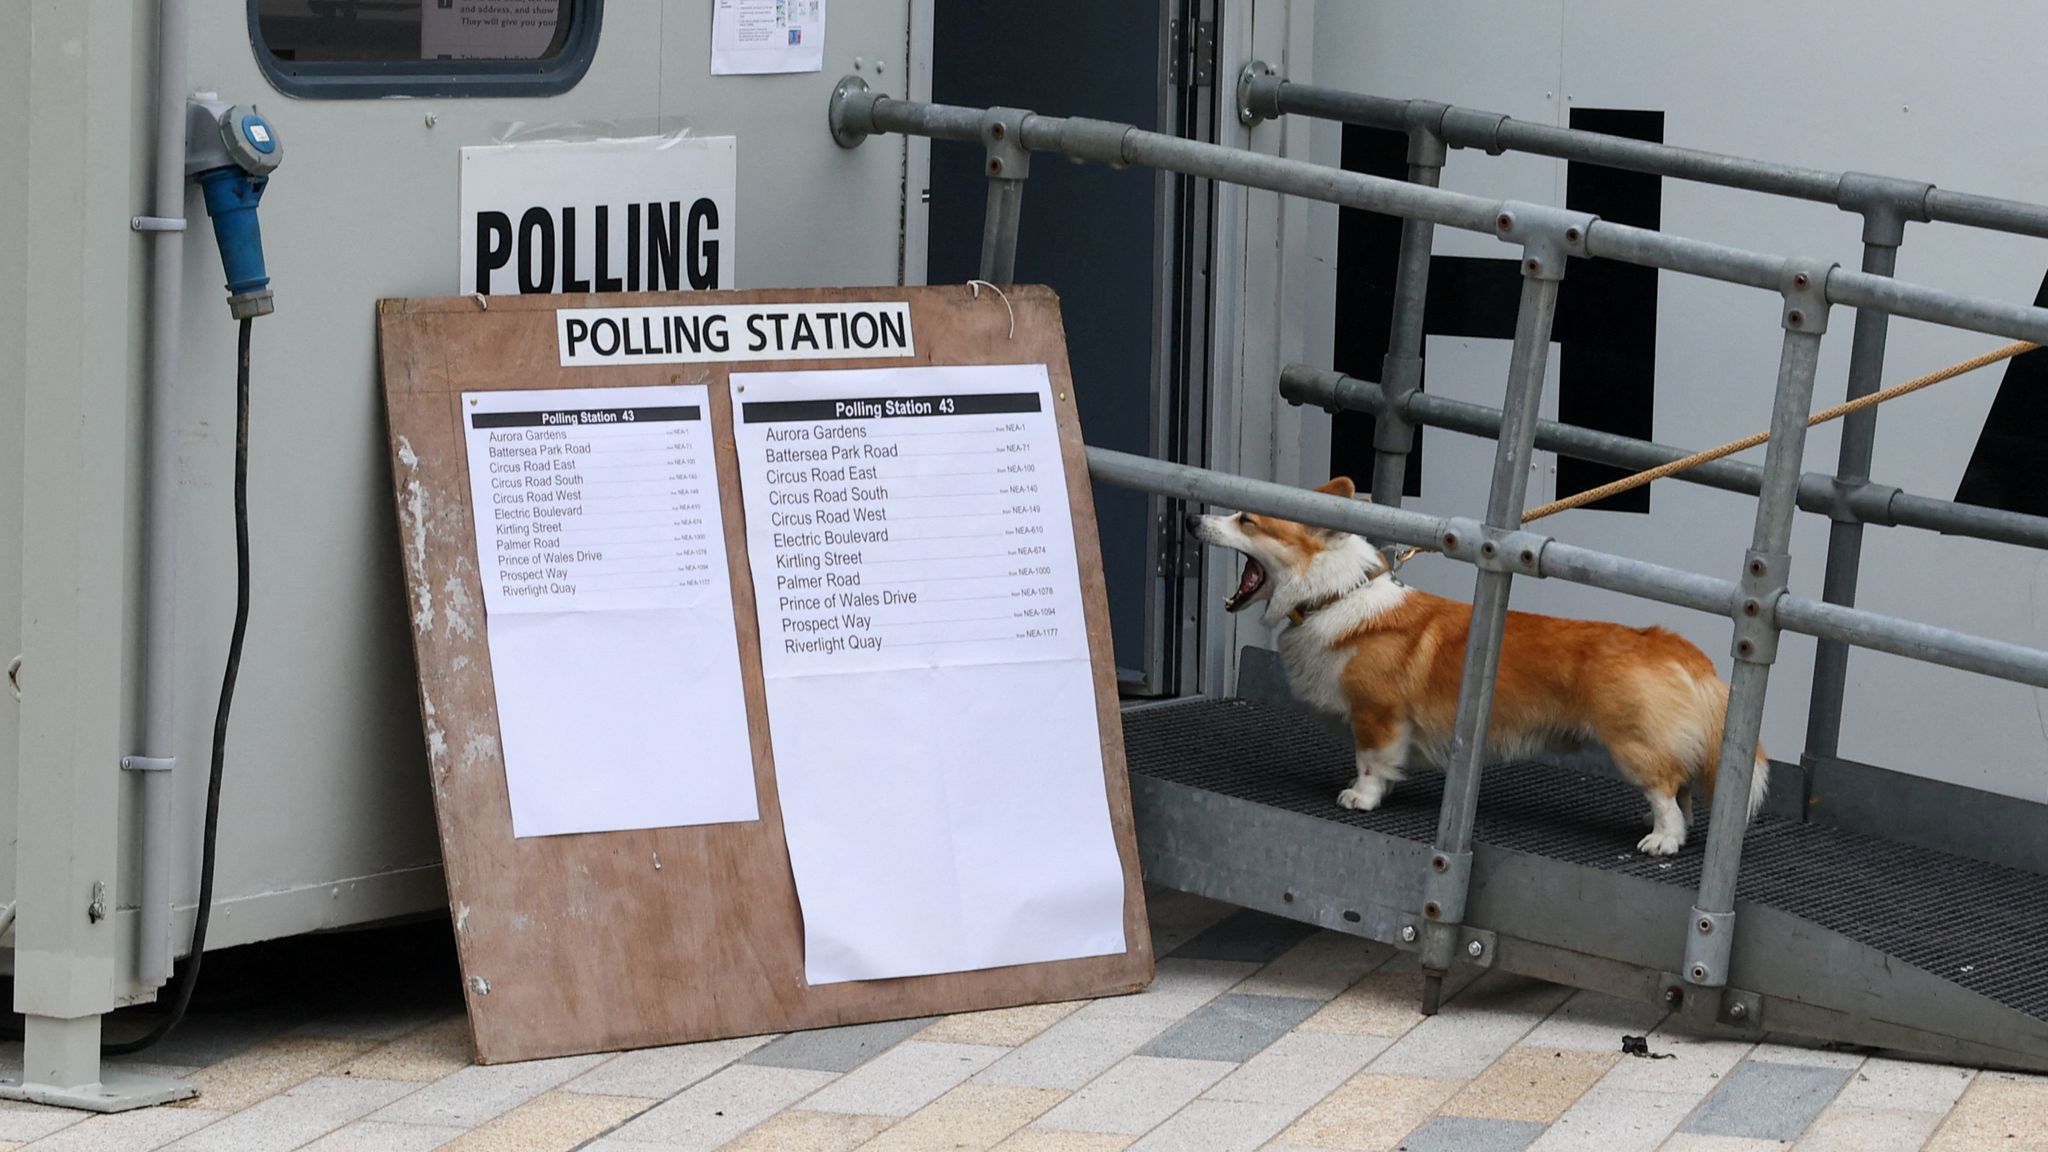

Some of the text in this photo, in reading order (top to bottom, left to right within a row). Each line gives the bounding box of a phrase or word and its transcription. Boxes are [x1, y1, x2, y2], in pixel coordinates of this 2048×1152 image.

[478, 6, 512, 14] address,
[515, 6, 529, 14] and
[532, 7, 553, 15] show
[461, 18, 481, 27] They
[501, 19, 517, 27] give
[476, 197, 719, 296] POLLING
[566, 311, 906, 357] POLLING STATION
[836, 399, 954, 418] Polling Station 43
[542, 410, 634, 425] Polling Station 43
[489, 429, 567, 443] Aurora Gardens
[766, 425, 867, 442] Aurora Gardens
[489, 443, 591, 458] Battersea Park Road
[766, 445, 898, 463] Battersea Park Road
[1007, 444, 1029, 452] NEA-71
[489, 460, 576, 473] Circus Road East
[1007, 464, 1035, 472] NEA-100
[491, 474, 583, 488] Circus Road South
[766, 467, 877, 484] Circus Road East
[769, 487, 888, 505] Circus Road South
[1010, 485, 1037, 493] NEA-140
[492, 490, 581, 504] Circus Road West
[494, 506, 582, 520] Electric Boulevard
[771, 509, 887, 527] Circus Road West
[496, 522, 562, 536] Kirtling Street
[1015, 526, 1043, 534] NEA-610
[496, 538, 560, 550] Palmer Road
[774, 529, 888, 548] Electric Boulevard
[1018, 547, 1046, 555] NEA-674
[498, 551, 602, 566] Prince of Wales Drive
[776, 551, 863, 570] Kirtling Street
[500, 568, 568, 582] Prospect Way
[1019, 567, 1050, 575] NEA-1000
[777, 572, 861, 590] Palmer Road
[503, 583, 576, 597] Riverlight Quay
[1021, 588, 1053, 596] NEA-1078
[780, 590, 917, 611] Prince of Wales Drive
[1024, 608, 1055, 616] NEA-1094
[782, 615, 871, 634] Prospect Way
[1026, 628, 1058, 637] NEA-1177
[785, 635, 882, 655] Riverlight Quay
